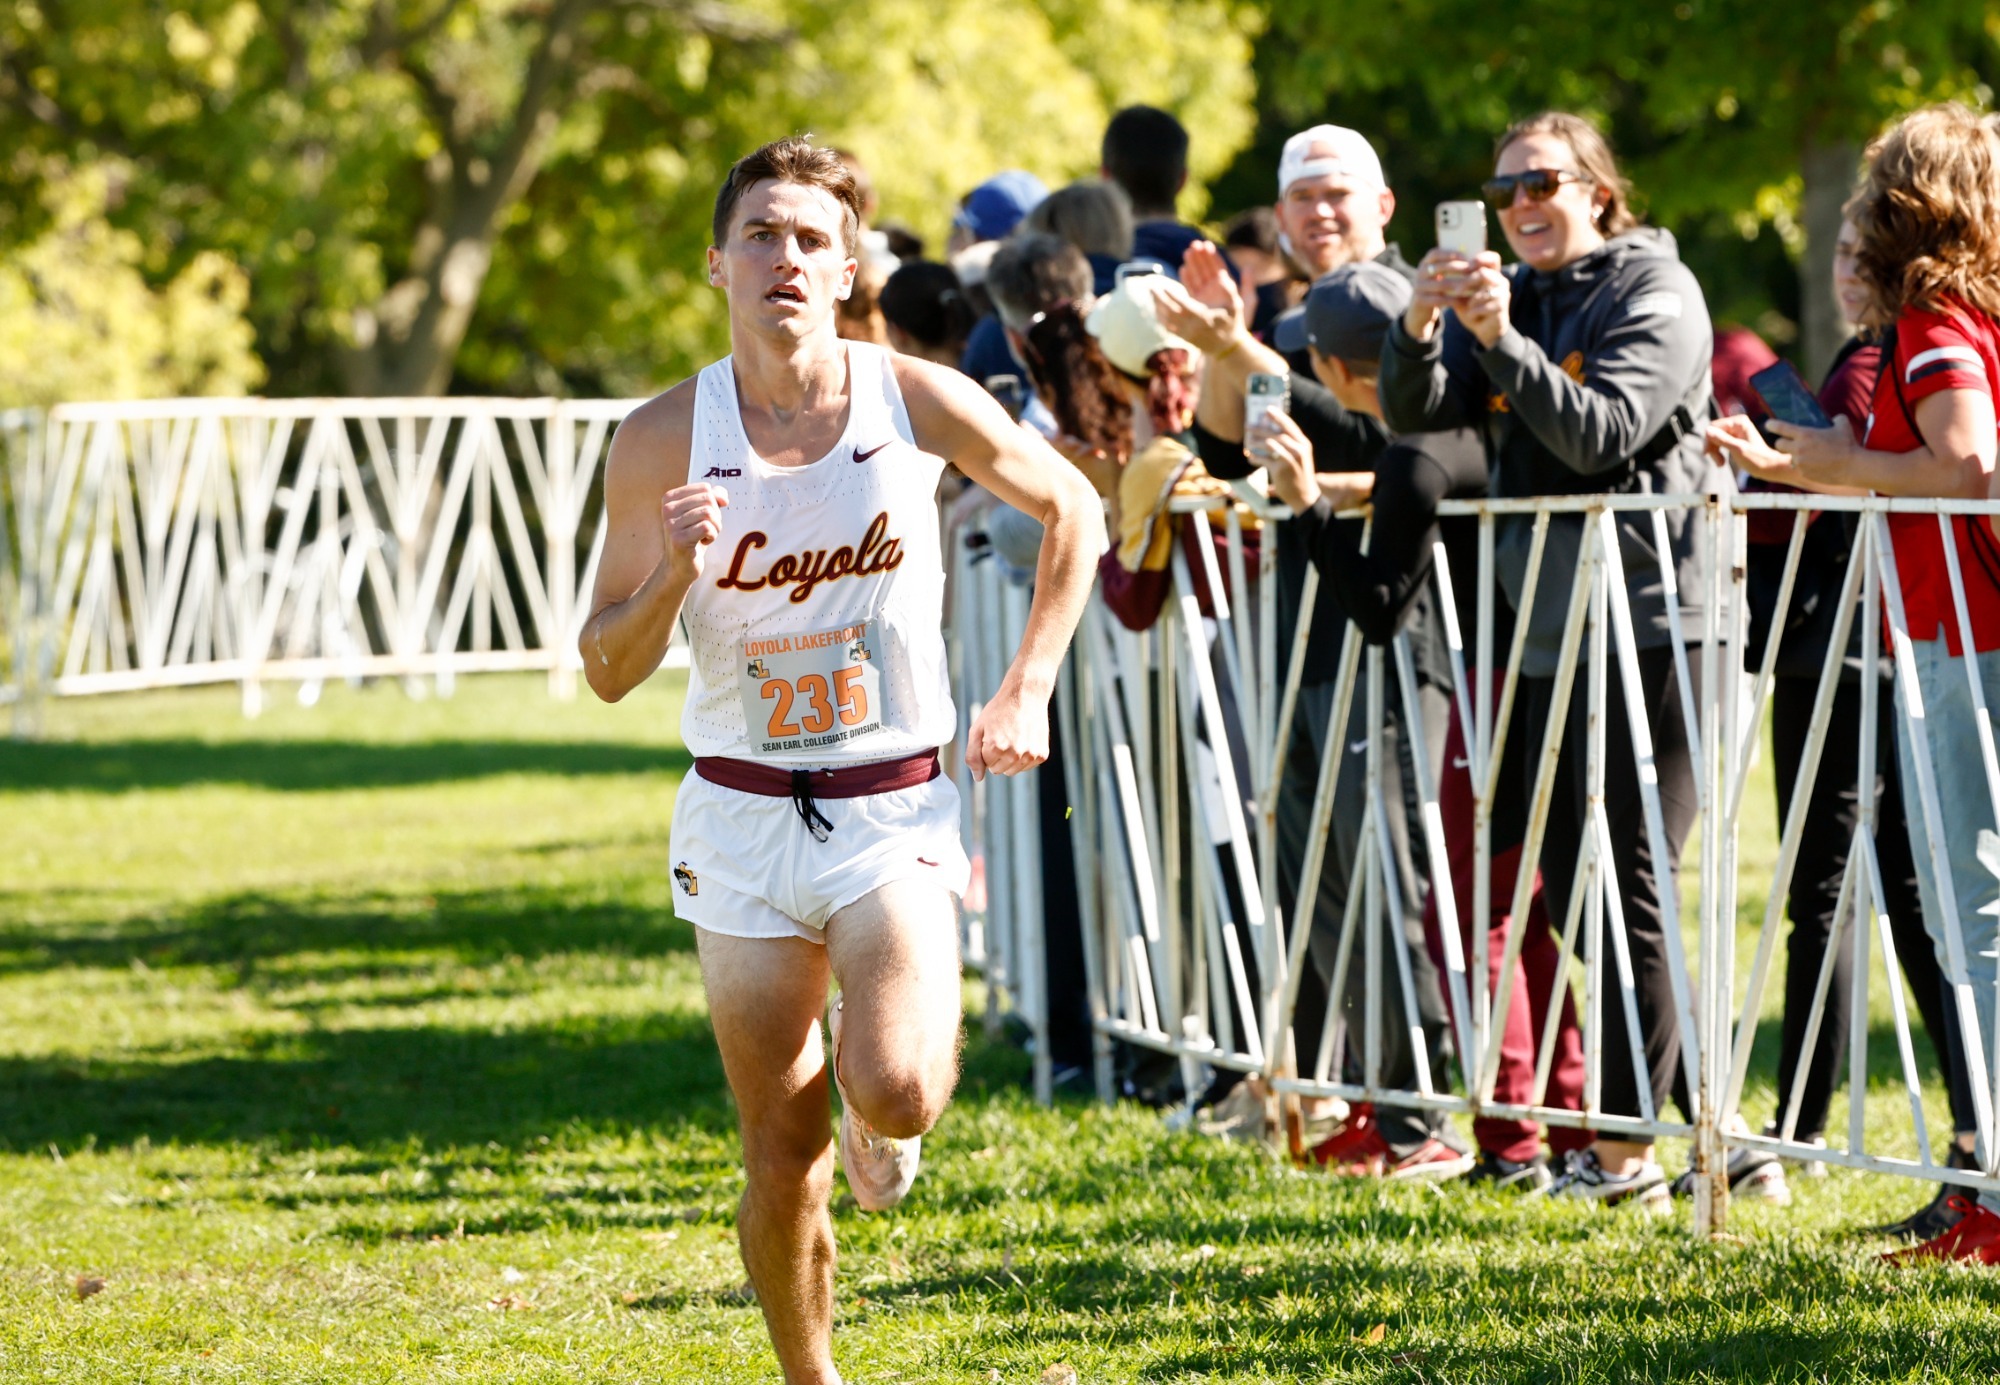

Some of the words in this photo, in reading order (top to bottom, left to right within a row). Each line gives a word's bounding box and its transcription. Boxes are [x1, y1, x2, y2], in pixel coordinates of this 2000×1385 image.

[703, 467, 742, 478] A10
[716, 511, 904, 604] Loyola
[745, 638, 792, 657] LOYOLA
[794, 624, 867, 651] LAKEFRONT
[760, 664, 868, 738] 235
[762, 742, 782, 752] SEAN
[783, 740, 802, 750] EARL
[803, 731, 848, 748] COLLEGIATE
[849, 722, 880, 739] DIVISION
